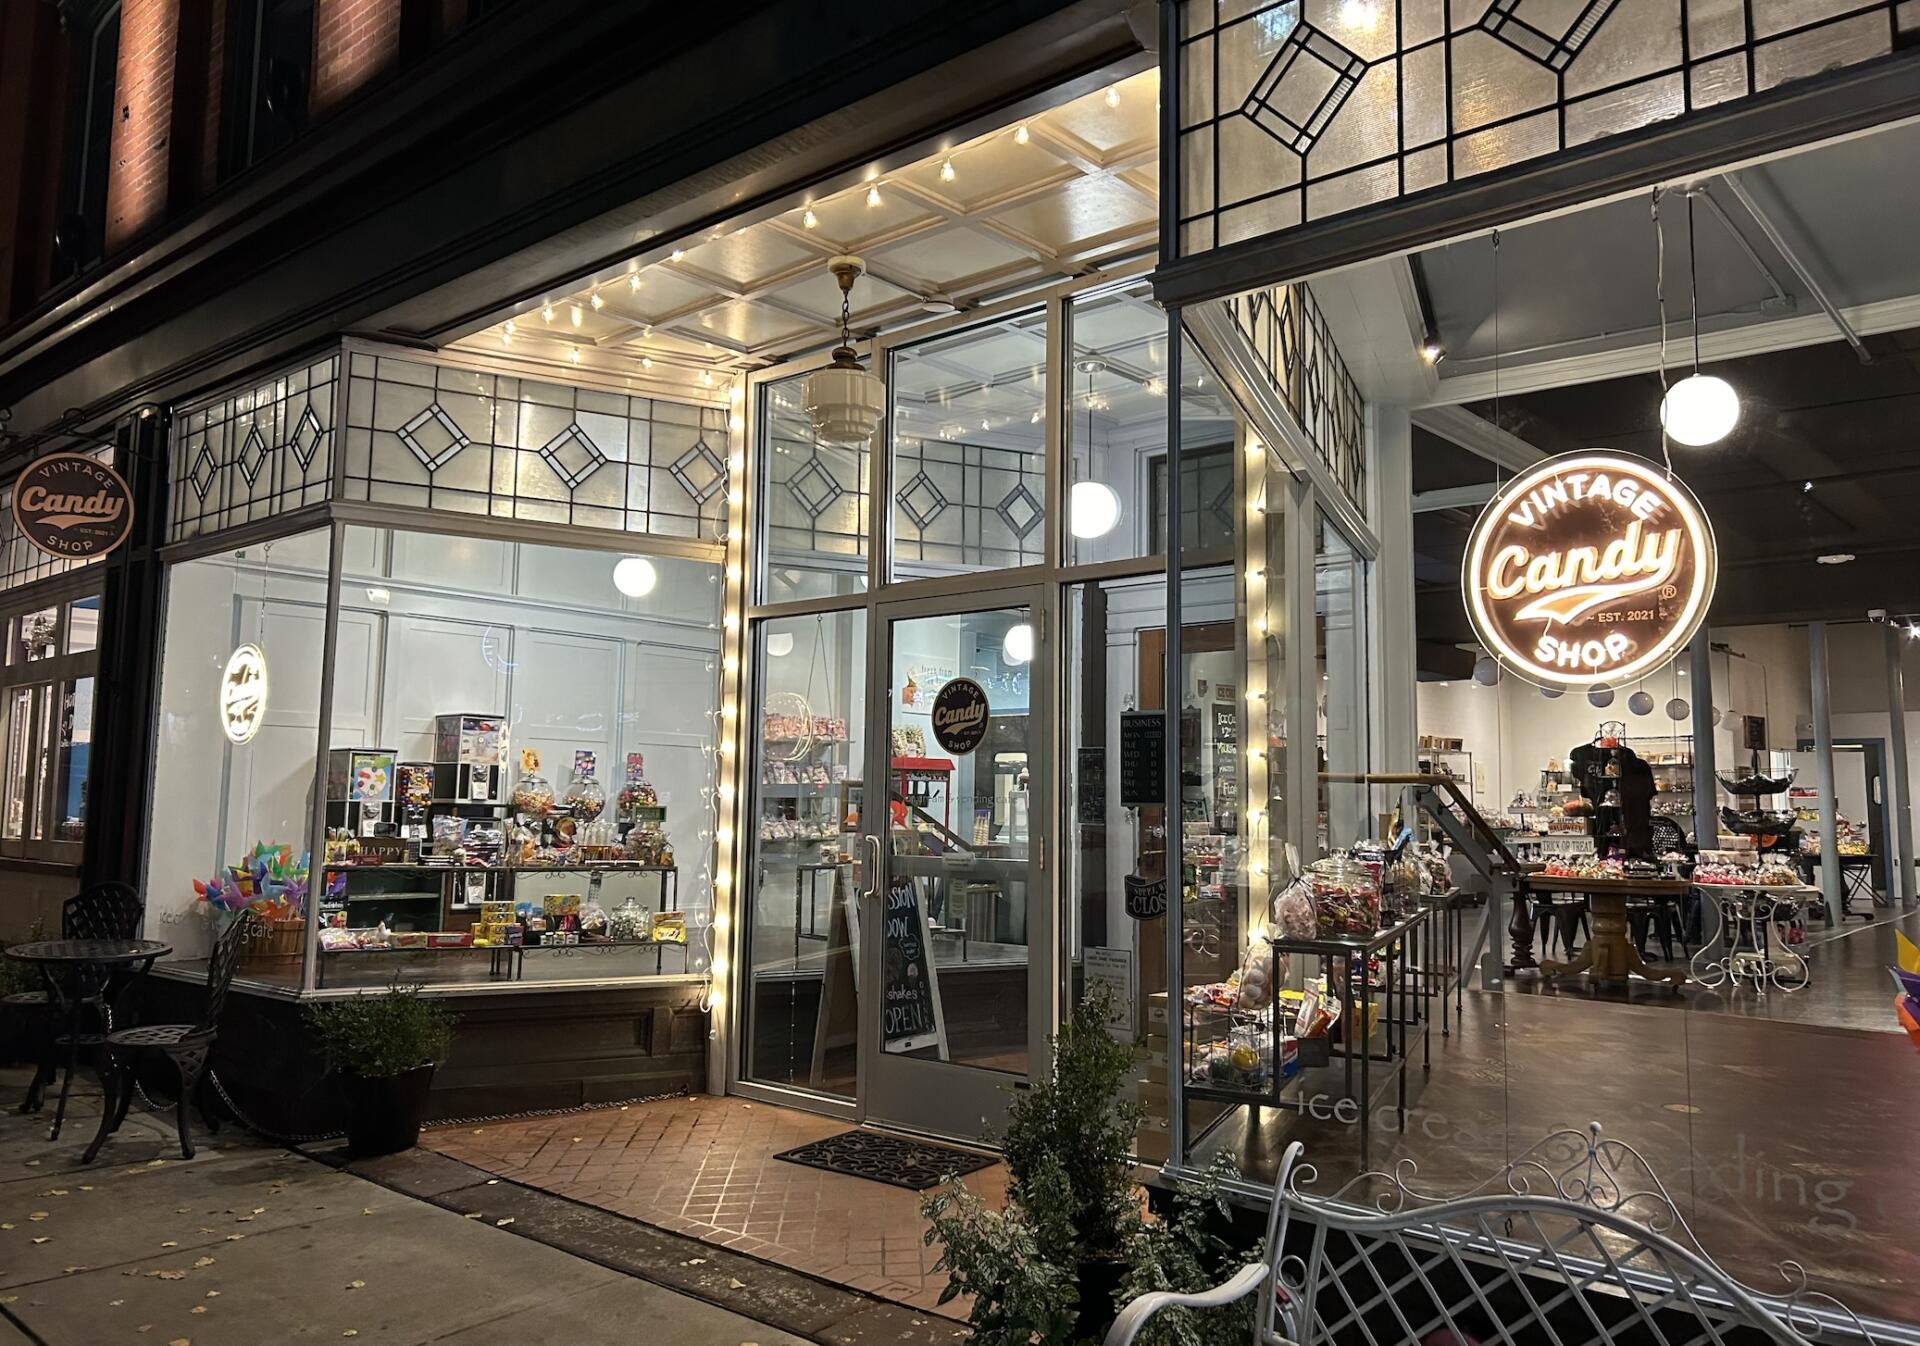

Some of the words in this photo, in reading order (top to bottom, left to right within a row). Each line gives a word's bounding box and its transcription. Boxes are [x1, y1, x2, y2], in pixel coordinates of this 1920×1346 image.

[39, 462, 114, 489] VINTAGE
[21, 486, 124, 522] Candy
[1508, 474, 1662, 527] VINTAGE
[47, 535, 94, 552] SHOP
[1487, 519, 1682, 606] Candy
[1598, 612, 1625, 623] EST.
[1627, 610, 1655, 621] 2021
[1533, 632, 1630, 669] SHOP
[942, 683, 979, 700] VINTAGE
[935, 700, 985, 726] Candy
[1123, 718, 1162, 728] BUSINESS
[948, 740, 972, 750] SHOP
[360, 847, 403, 857] HAPPY
[1543, 841, 1560, 852] TRICK
[1561, 841, 1571, 852] OR
[1572, 841, 1593, 852] TREAT
[251, 923, 274, 940] cafe
[886, 1004, 923, 1034] OPEN
[1298, 1090, 1359, 1124] ice
